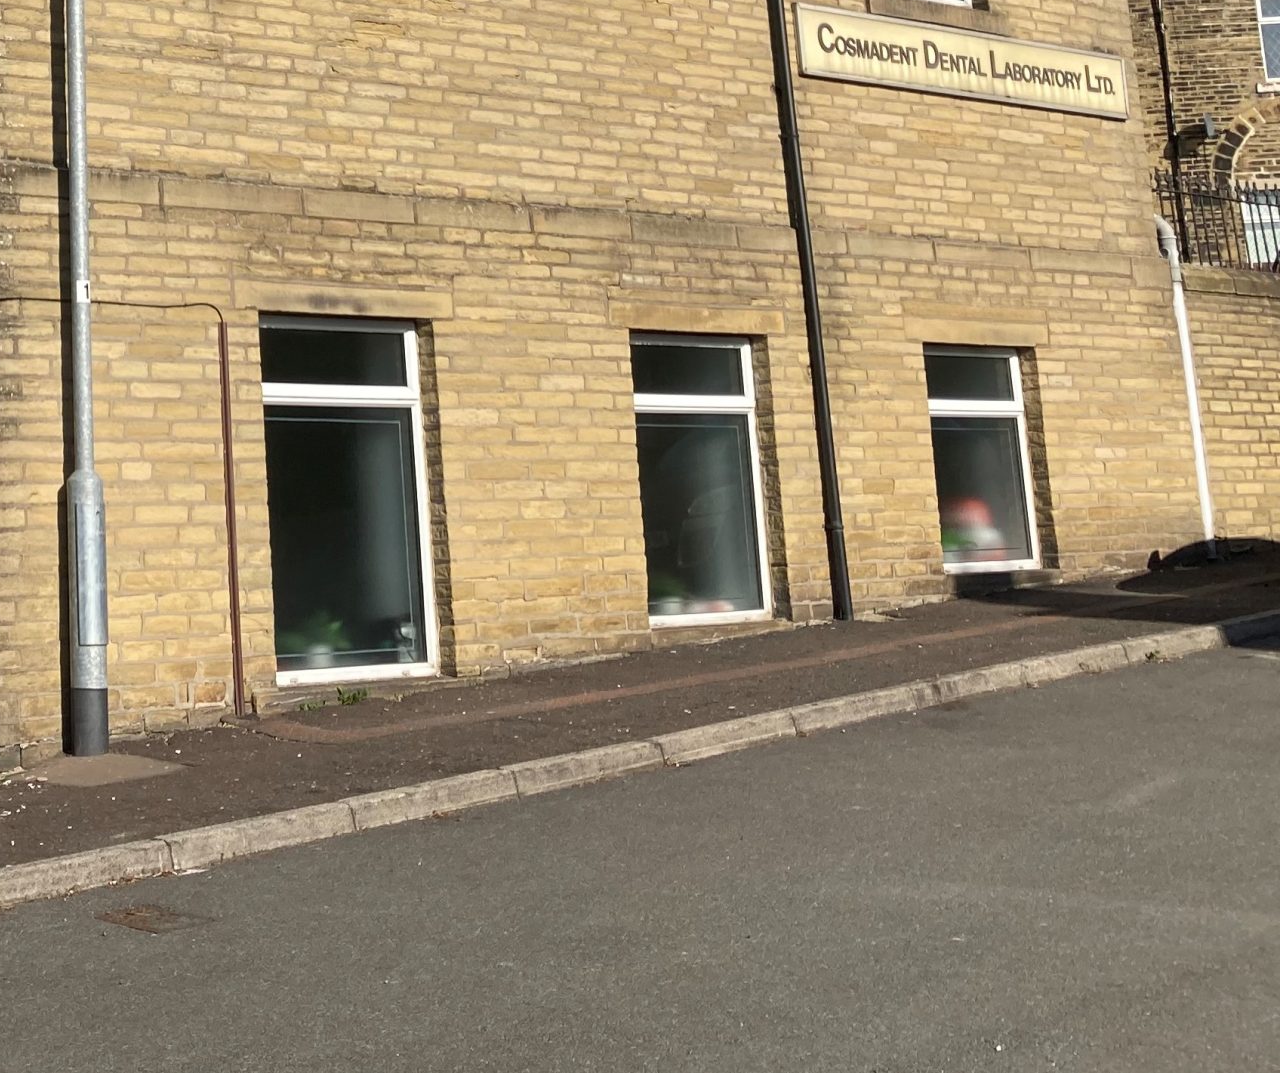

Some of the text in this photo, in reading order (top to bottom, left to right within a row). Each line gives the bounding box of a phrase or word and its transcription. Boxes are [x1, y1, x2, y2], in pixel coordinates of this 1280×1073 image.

[817, 22, 918, 67] COSMADENT
[922, 40, 987, 77] DENTAL
[989, 50, 1082, 90] LABORATORY
